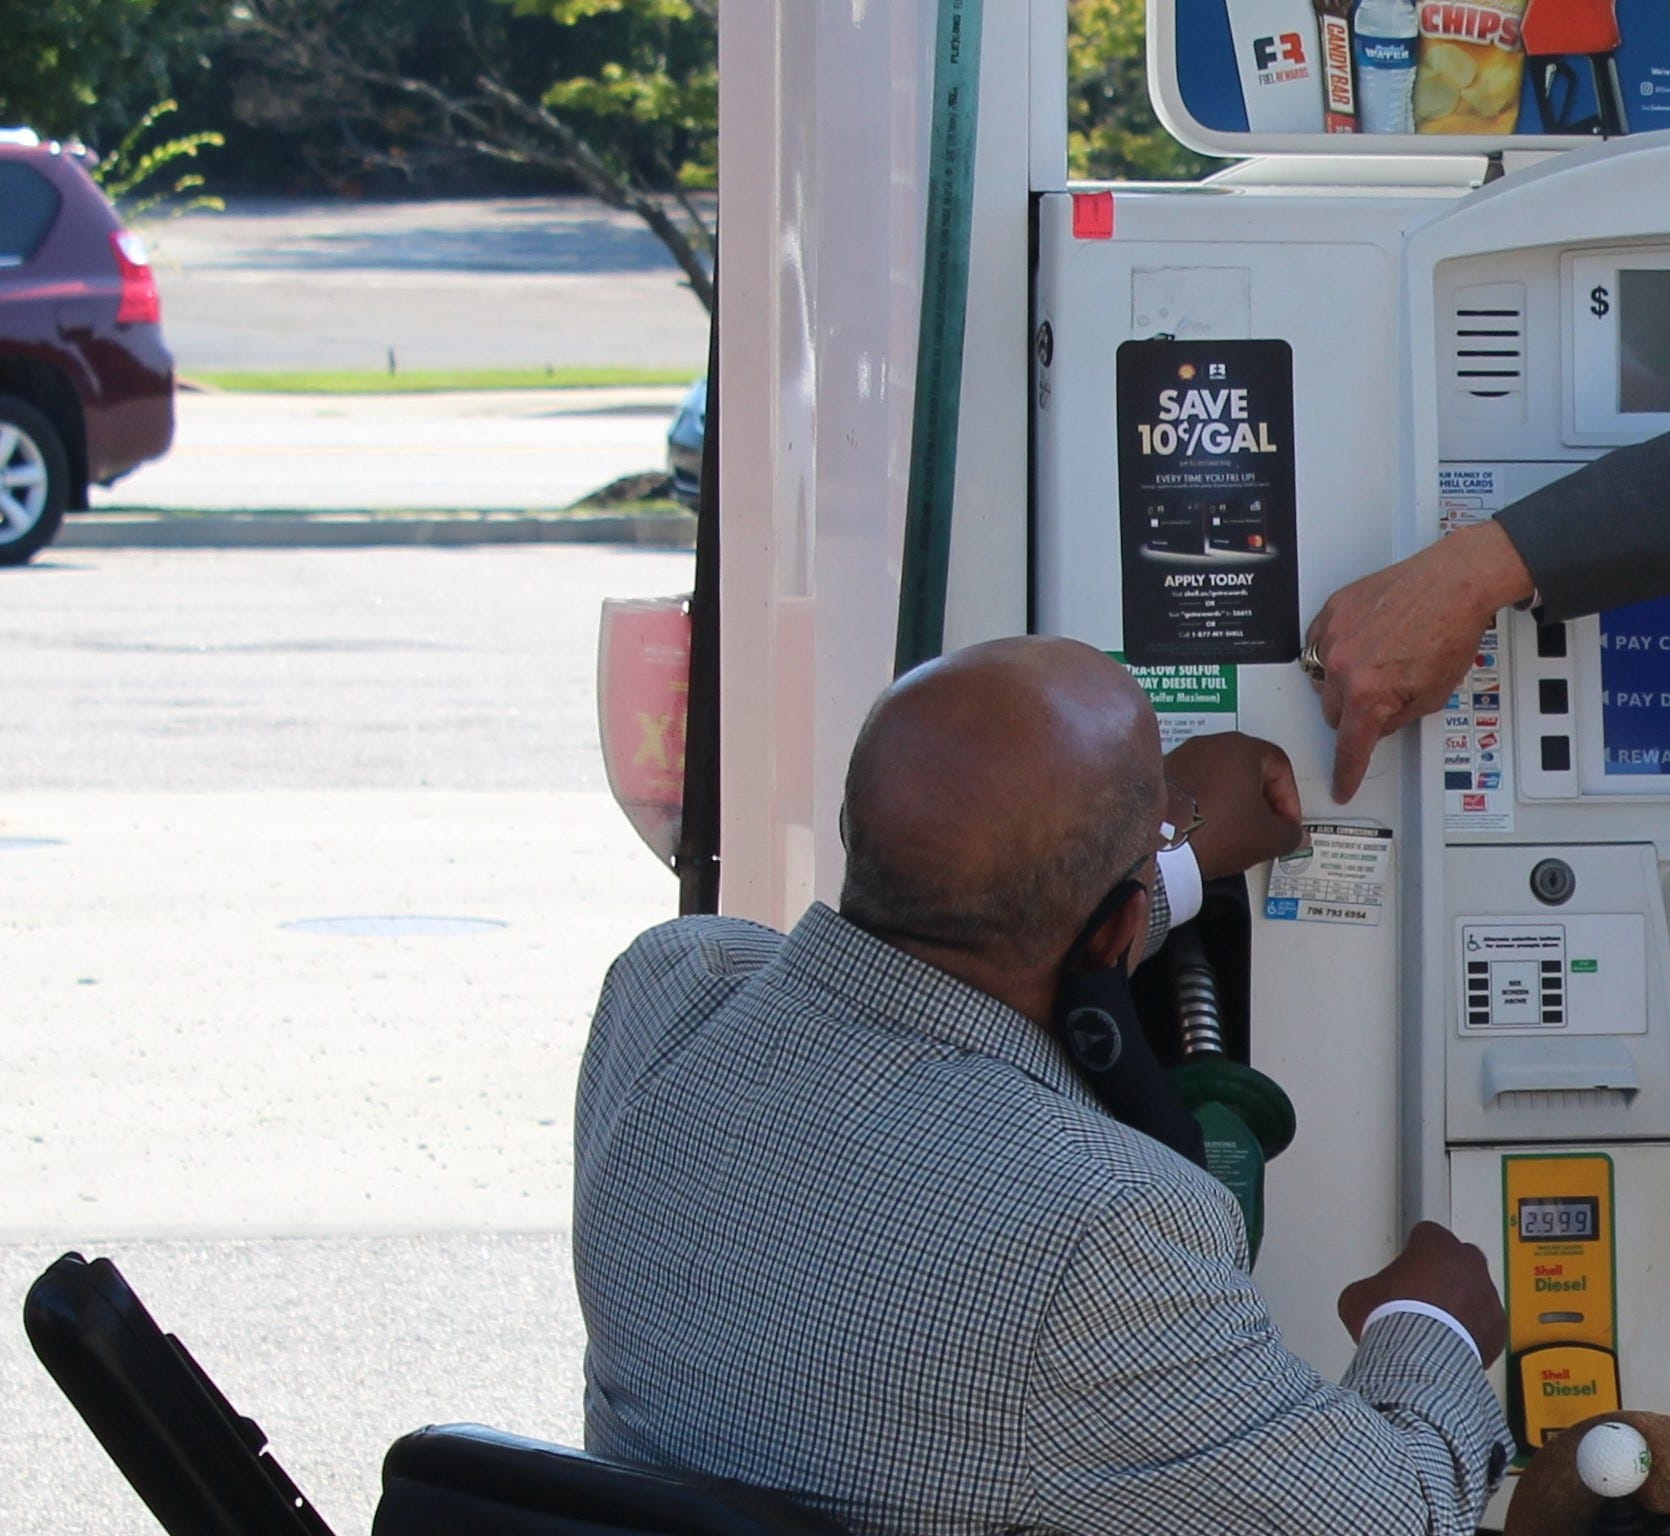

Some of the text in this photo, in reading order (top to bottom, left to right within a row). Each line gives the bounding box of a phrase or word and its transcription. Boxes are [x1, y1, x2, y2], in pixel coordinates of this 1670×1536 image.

[1420, 5, 1521, 46] CHIPS
[1327, 22, 1348, 74] CANDY
[1365, 48, 1410, 59] WATER
[1331, 74, 1350, 106] BAR
[1590, 284, 1610, 319] $
[1159, 388, 1248, 421] SAVE
[1138, 421, 1277, 456] 10¢/GAL
[1156, 474, 1181, 484] EVERY
[1183, 474, 1202, 483] TIME
[1205, 473, 1225, 483] YOU
[1226, 473, 1239, 482] FILL
[1164, 573, 1254, 587] APPLY TODAY
[1615, 635, 1652, 650] PAY
[1127, 665, 1220, 676] TRA-LOW SULFUR
[1162, 677, 1198, 689] DIESEL
[1201, 677, 1228, 689] FUEL
[1150, 692, 1175, 703] Sulfur
[1616, 693, 1654, 707] PAY
[1446, 717, 1469, 726] VISA
[1445, 737, 1468, 749] STAR
[1525, 1211, 1588, 1233] 2.999
[1534, 1264, 1563, 1276] Shell
[1535, 1275, 1587, 1292] Diesel
[1541, 1369, 1570, 1380] Shell
[1542, 1380, 1597, 1396] Diesel
